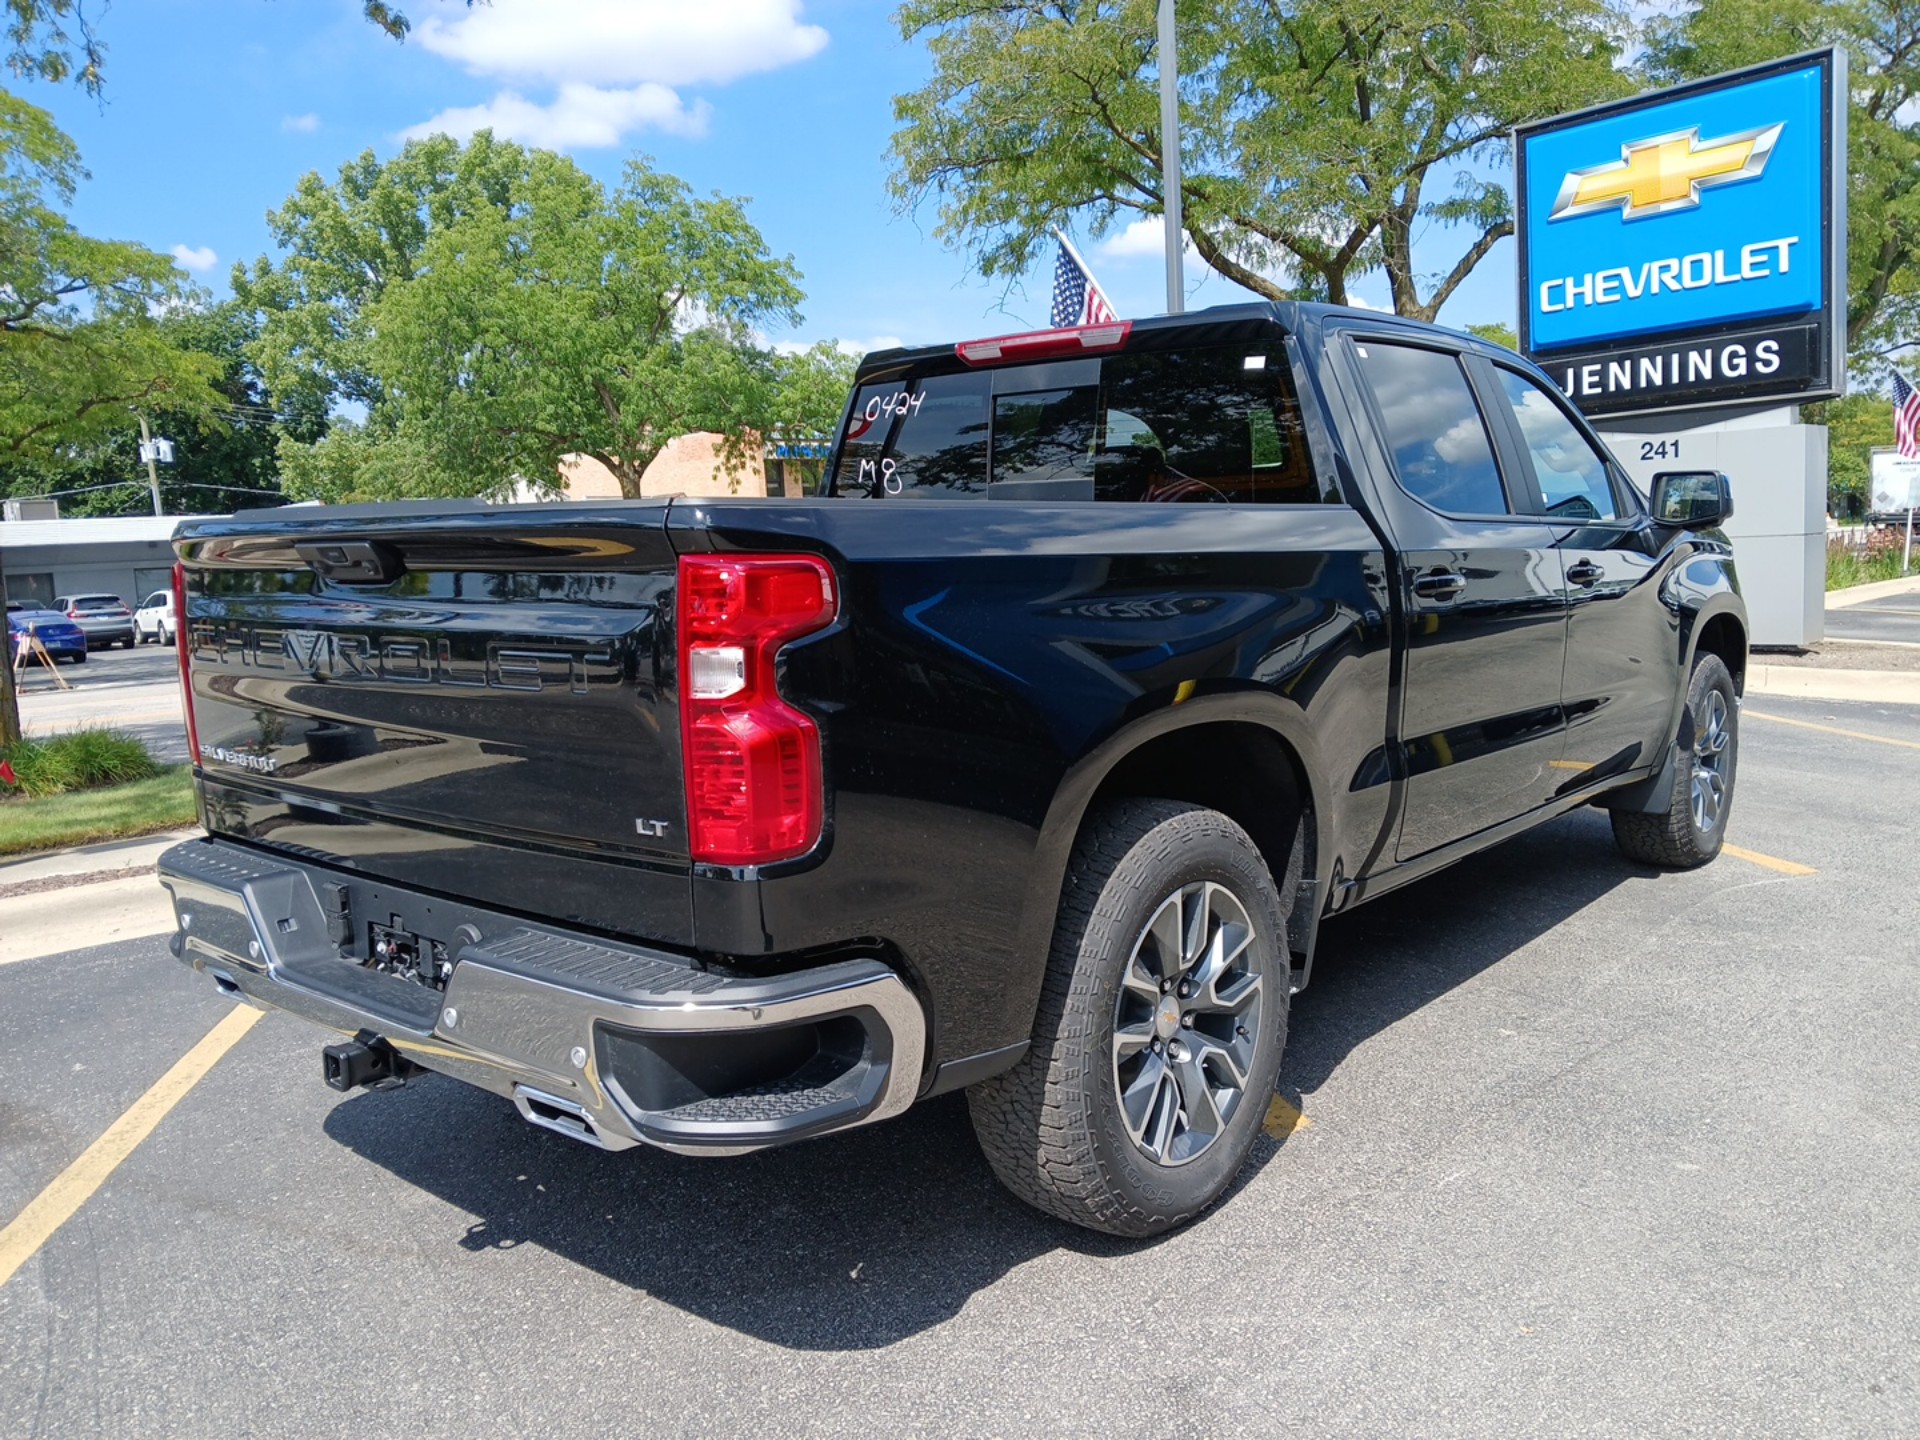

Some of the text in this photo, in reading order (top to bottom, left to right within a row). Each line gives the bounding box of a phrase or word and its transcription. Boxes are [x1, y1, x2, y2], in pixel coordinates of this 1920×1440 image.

[1540, 236, 1799, 314] CHEVROLET
[1559, 340, 1781, 398] JENNINGS
[866, 390, 926, 421] 0424
[1640, 440, 1680, 461] 241
[192, 623, 611, 696] CHEVROLET
[636, 818, 668, 837] LT
